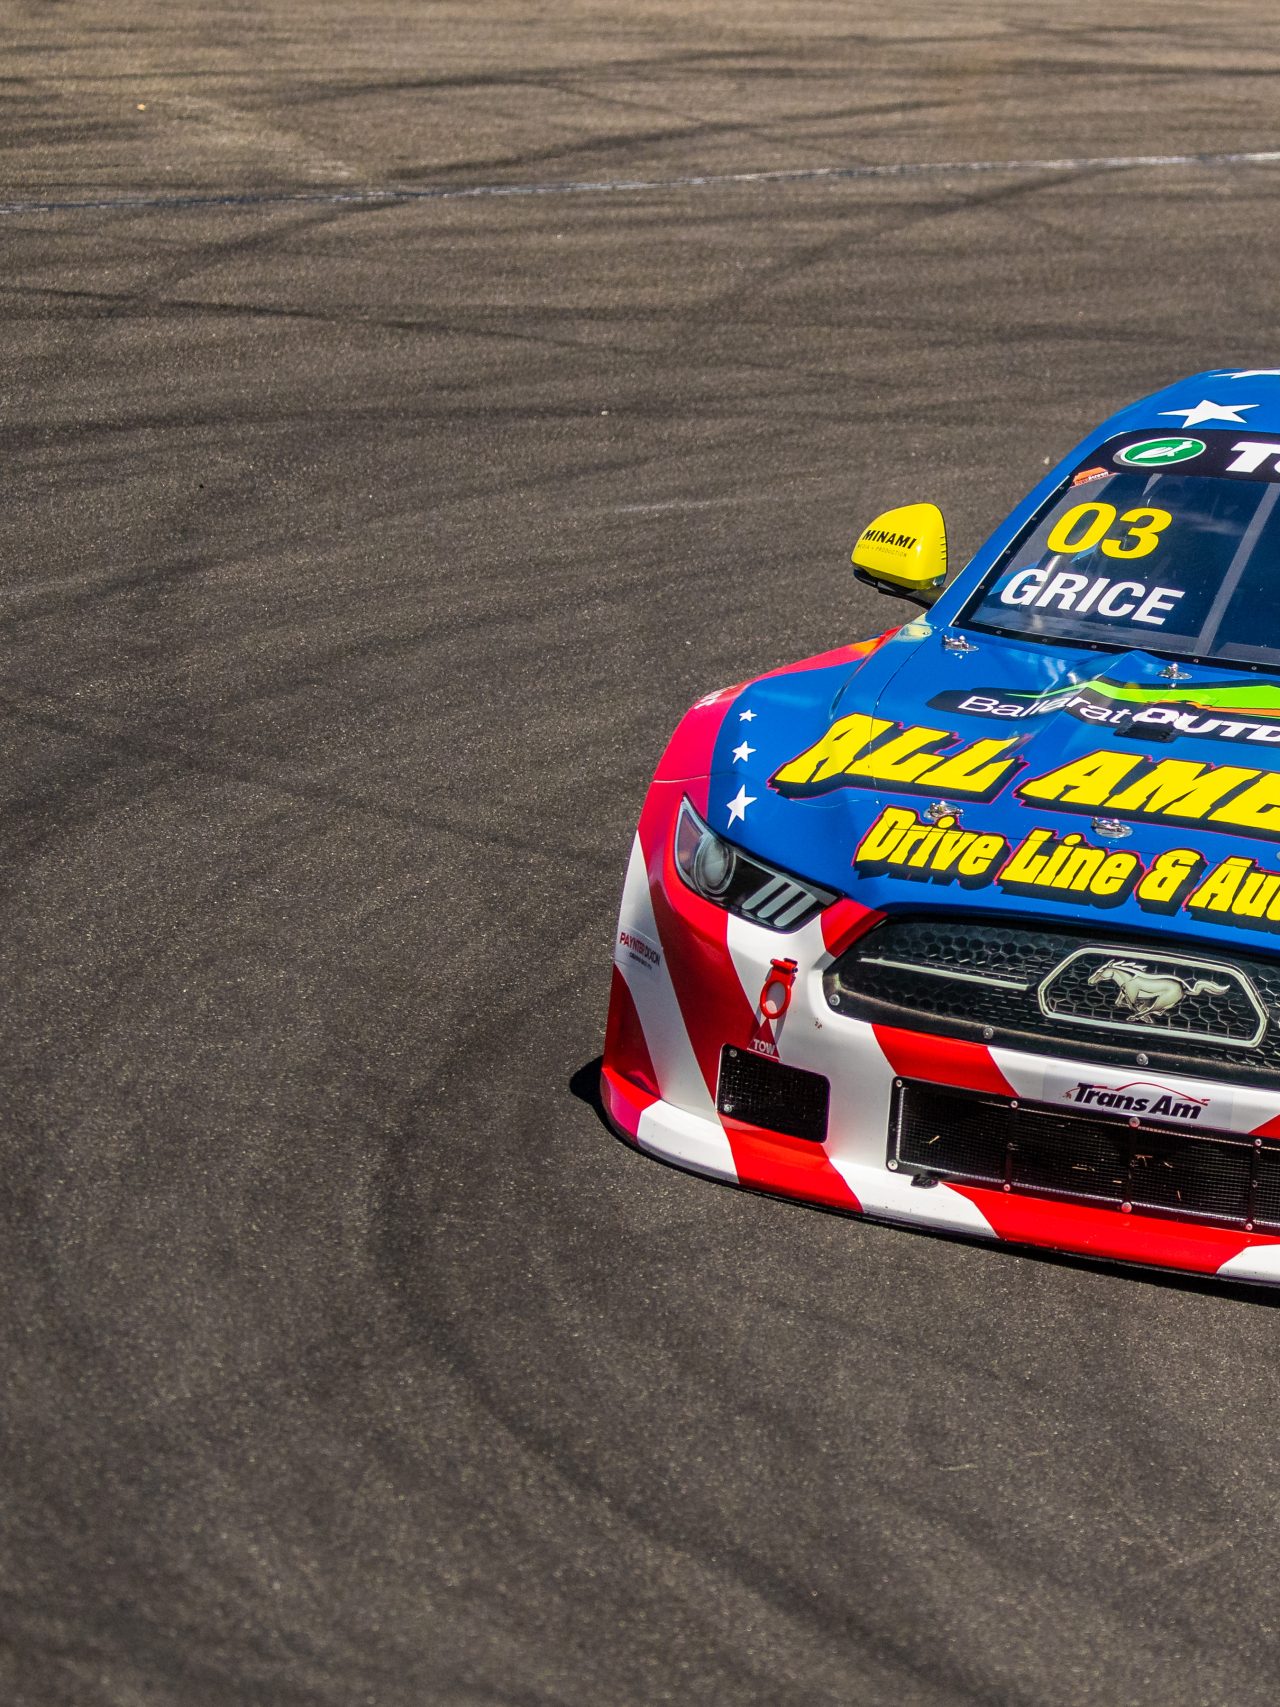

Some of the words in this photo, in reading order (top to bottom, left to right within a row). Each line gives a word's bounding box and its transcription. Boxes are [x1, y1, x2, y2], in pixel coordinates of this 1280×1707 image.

[862, 529, 918, 550] MINAMI
[1046, 502, 1173, 560] 03
[1000, 567, 1185, 626] GRICE
[957, 695, 1132, 725] Ballarat
[772, 712, 1023, 795] ALL
[855, 806, 1005, 876] Drive
[999, 829, 1137, 896] Line
[1138, 848, 1200, 902] &
[753, 1038, 776, 1056] TOW
[1074, 1082, 1150, 1112] Trans
[1148, 1095, 1202, 1119] Am
